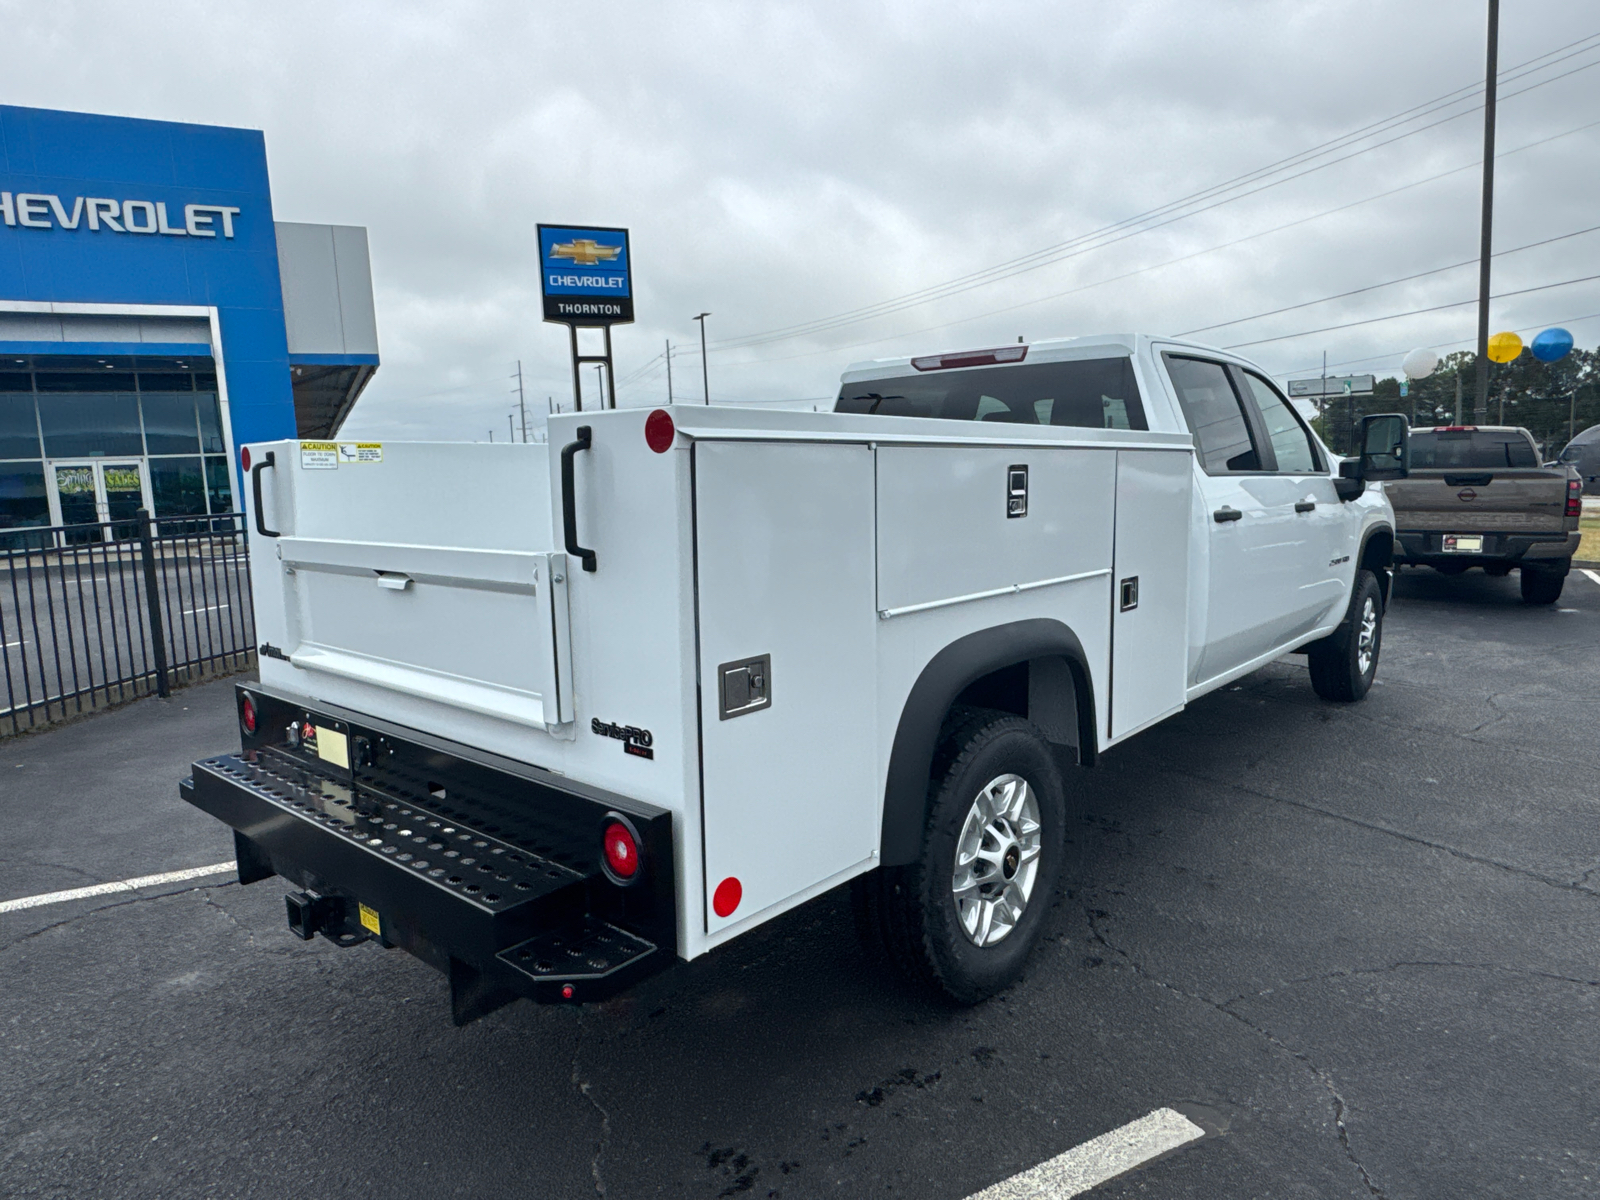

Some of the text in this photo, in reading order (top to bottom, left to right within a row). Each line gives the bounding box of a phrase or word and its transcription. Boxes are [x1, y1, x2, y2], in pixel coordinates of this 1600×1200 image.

[549, 275, 624, 288] CHEVROLET
[558, 303, 621, 315] THORNTON
[591, 717, 653, 747] ServicePRO
